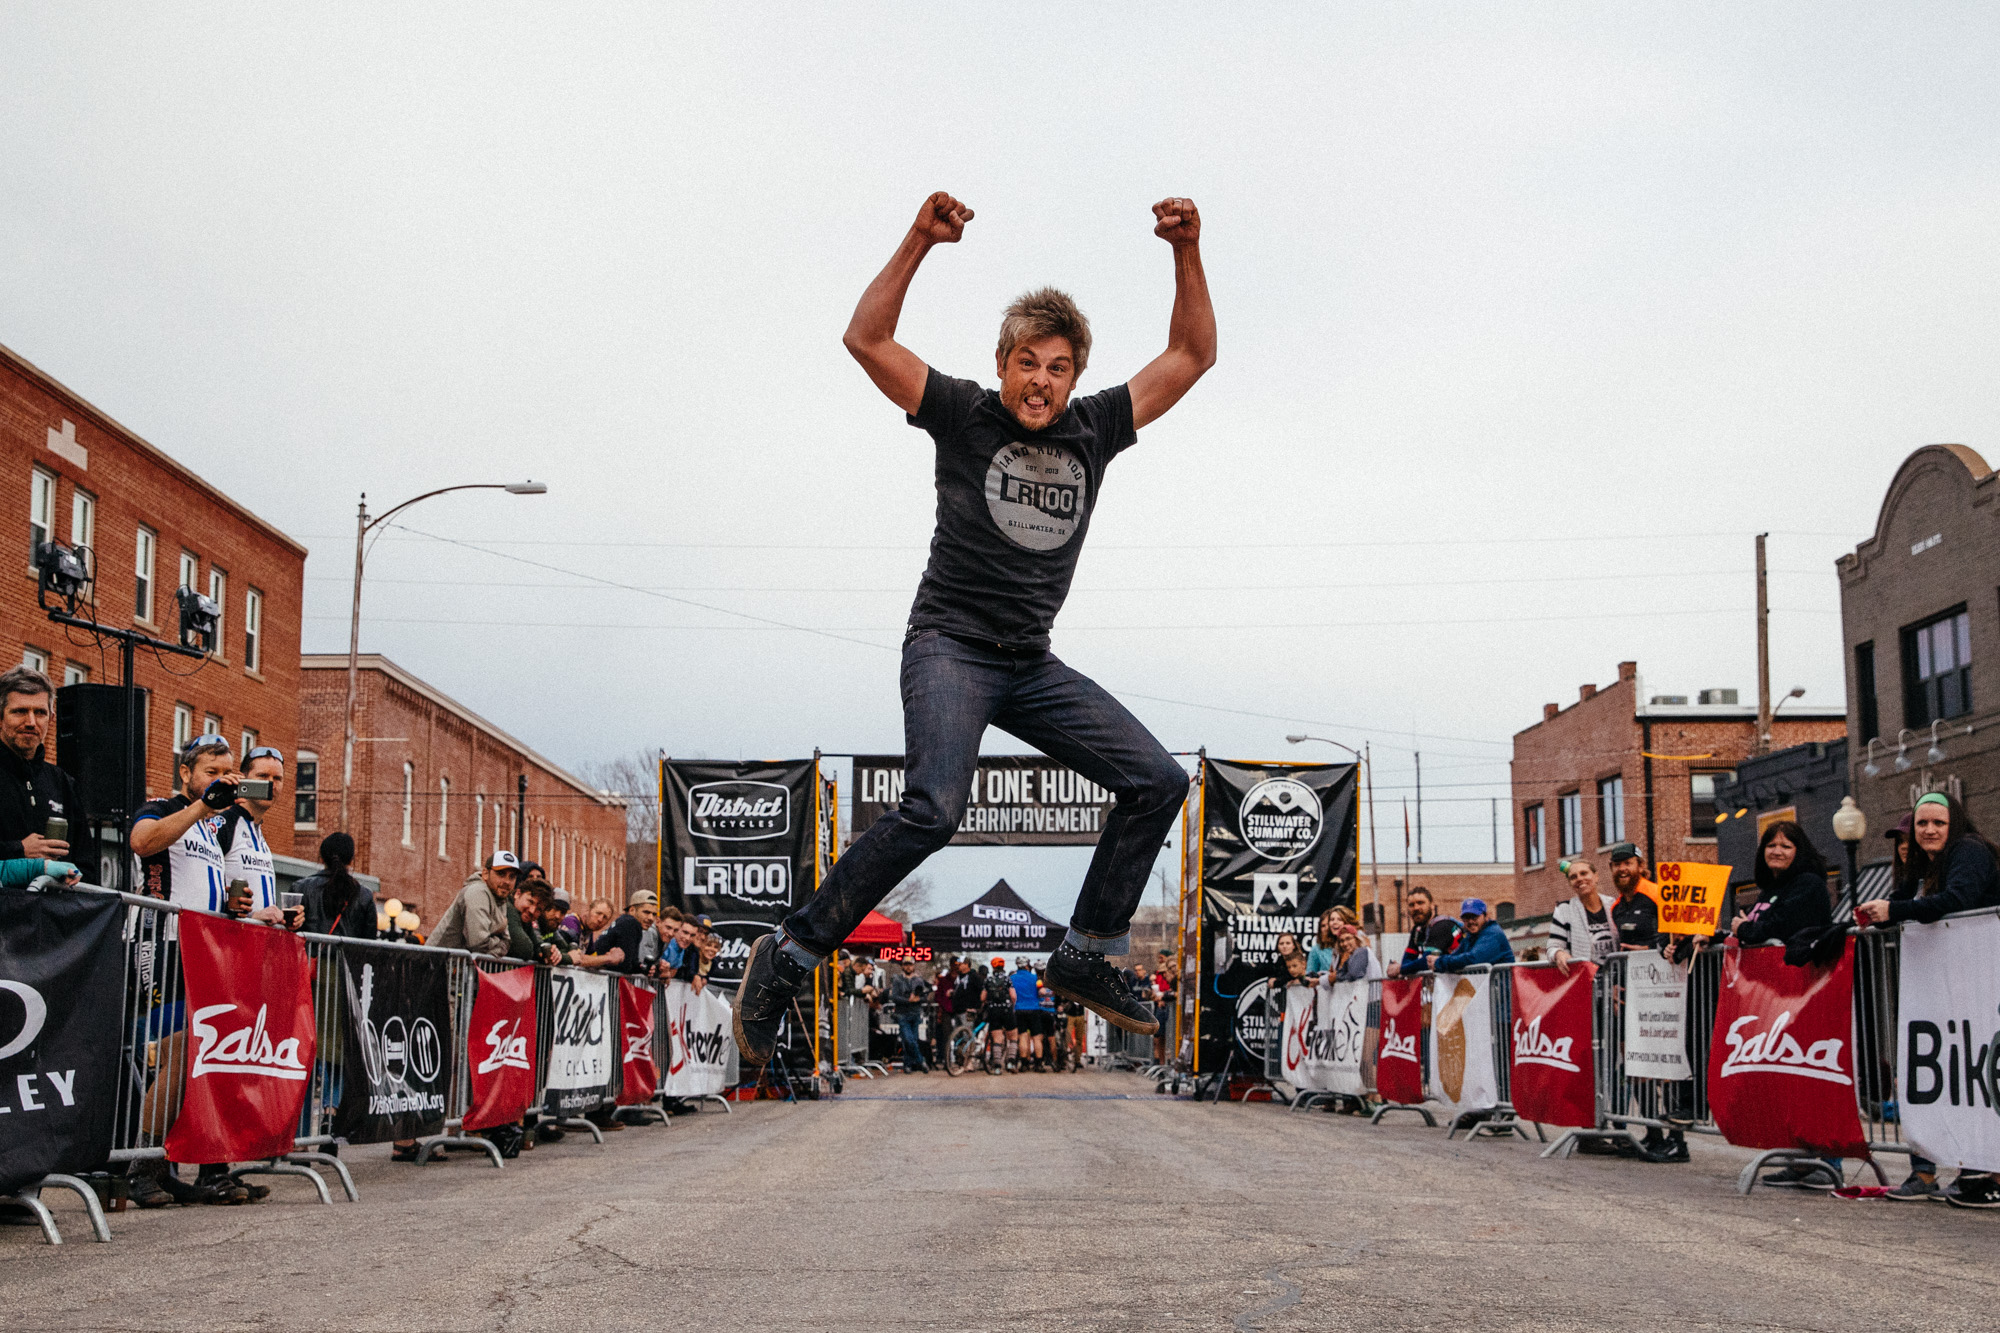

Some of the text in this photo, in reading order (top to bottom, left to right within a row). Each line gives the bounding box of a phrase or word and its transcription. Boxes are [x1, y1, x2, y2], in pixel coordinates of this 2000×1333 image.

[999, 446, 1083, 481] LAND RUN 100
[1025, 464, 1059, 475] EST. 2013
[1000, 472, 1075, 513] LR100
[861, 769, 904, 803] LAN
[987, 769, 1034, 804] ONE
[1041, 769, 1116, 804] HUND
[695, 792, 783, 817] District
[702, 820, 774, 828] BICYCLES
[1247, 814, 1311, 828] STILLWATER
[1247, 826, 1314, 840] SUMMIT CO.
[184, 838, 222, 864] Walmart
[684, 856, 787, 895] LR100
[1660, 863, 1681, 882] GO
[973, 904, 1028, 922] LR100
[961, 924, 1046, 938] LAND RUN 100
[1241, 951, 1269, 964] ELEV.
[192, 1003, 307, 1080] Salsa
[478, 1017, 530, 1075] Sala
[1514, 1015, 1581, 1072] Salsa
[1720, 1010, 1853, 1086] Salsa
